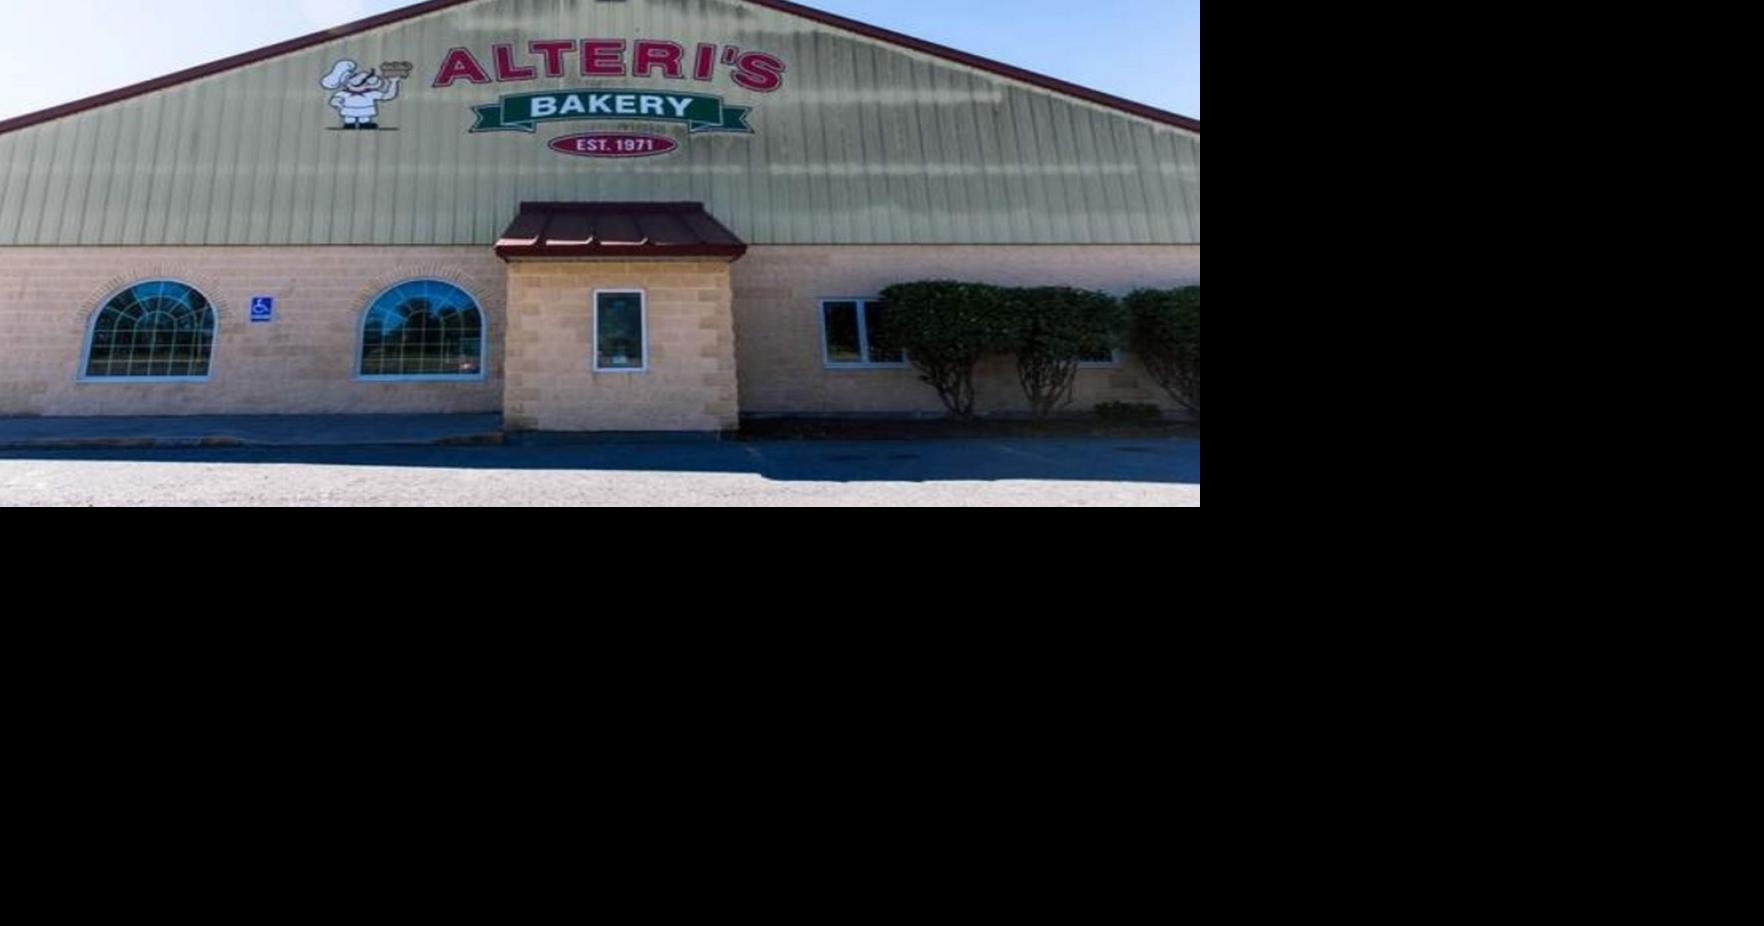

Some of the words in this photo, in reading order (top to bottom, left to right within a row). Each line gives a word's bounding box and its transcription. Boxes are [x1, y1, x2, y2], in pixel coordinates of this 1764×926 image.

[433, 38, 786, 92] ALTERI'S
[530, 94, 693, 118] BAKERY
[576, 138, 609, 152] EST.
[616, 138, 653, 152] 1971
